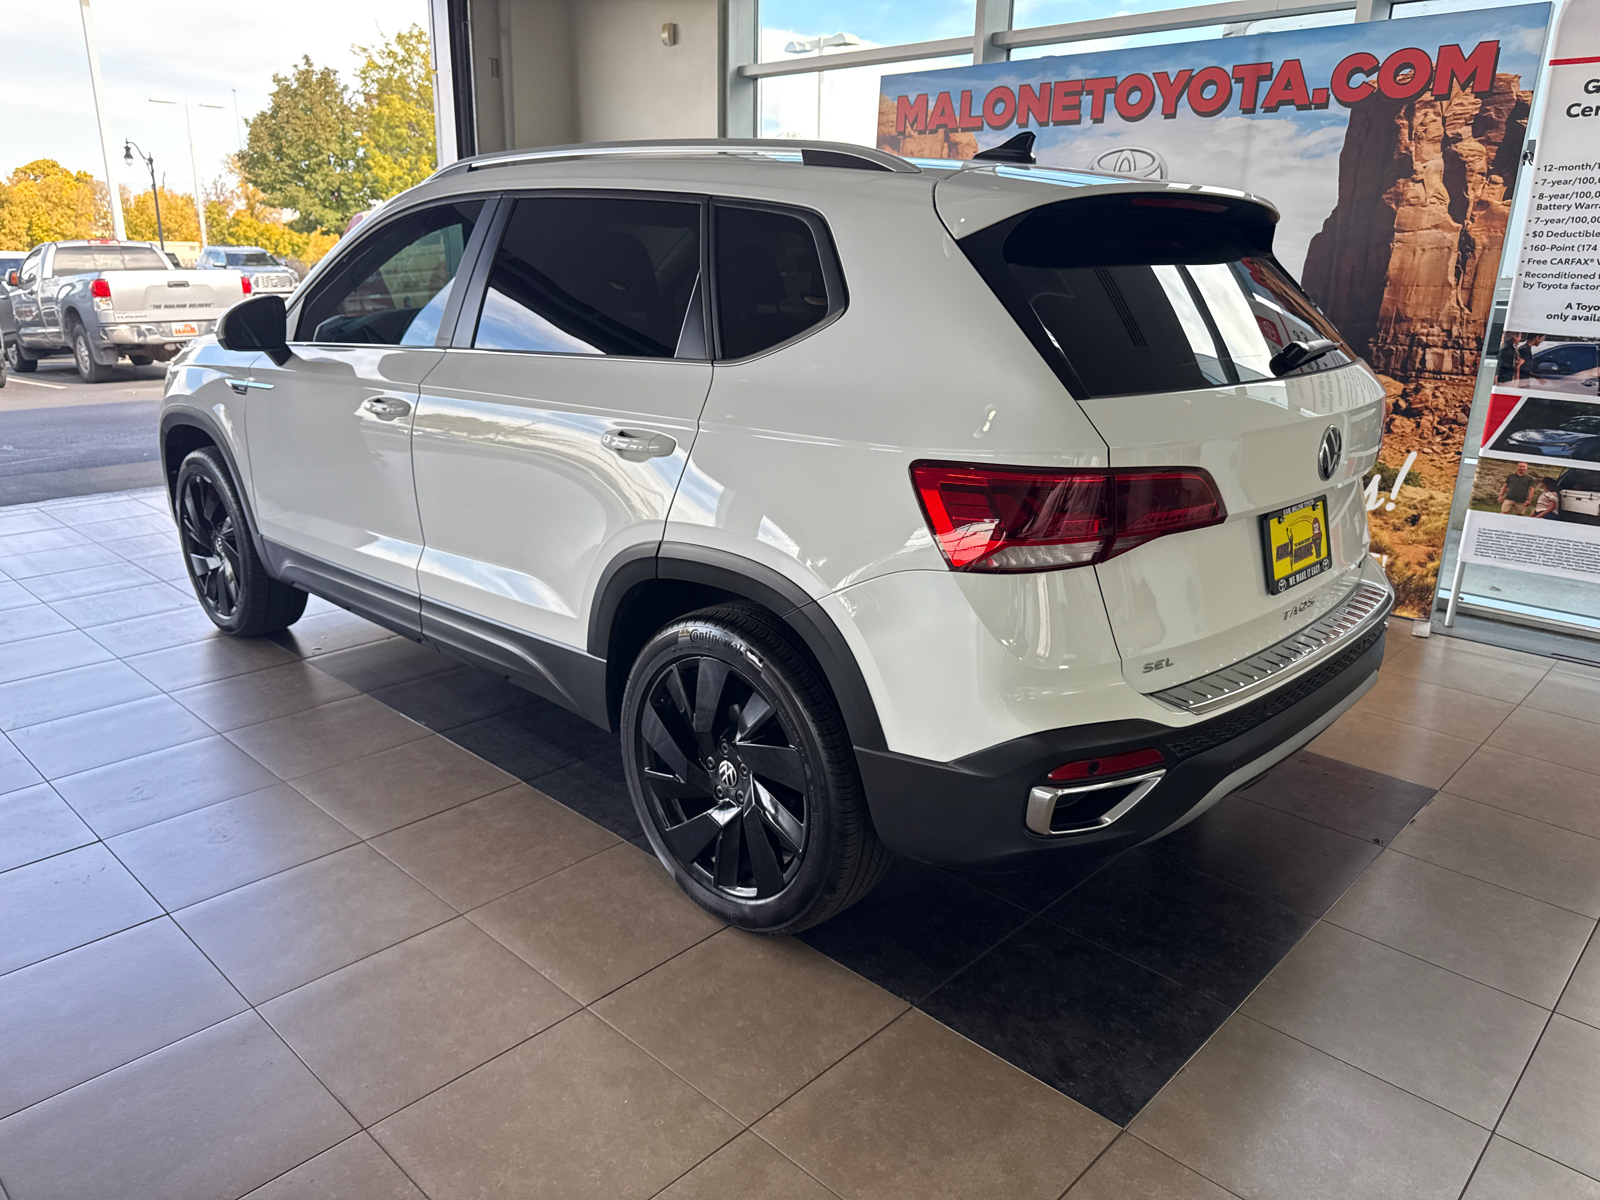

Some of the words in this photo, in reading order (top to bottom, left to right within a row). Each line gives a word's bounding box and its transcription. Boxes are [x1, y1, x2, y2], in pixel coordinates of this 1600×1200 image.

[894, 40, 1501, 133] MALONETOYOTA.COM
[1536, 203, 1572, 212] Battery
[1532, 230, 1544, 239] $0
[1530, 244, 1575, 252] 160-Point
[1577, 244, 1598, 253] (174
[1527, 257, 1548, 266] Free
[1524, 271, 1596, 280] Reconditioned
[1523, 281, 1535, 290] by
[1537, 281, 1568, 291] Toyota
[1571, 282, 1600, 292] factor
[1565, 302, 1573, 310] A
[1546, 312, 1569, 322] only
[1143, 657, 1175, 674] SEL
